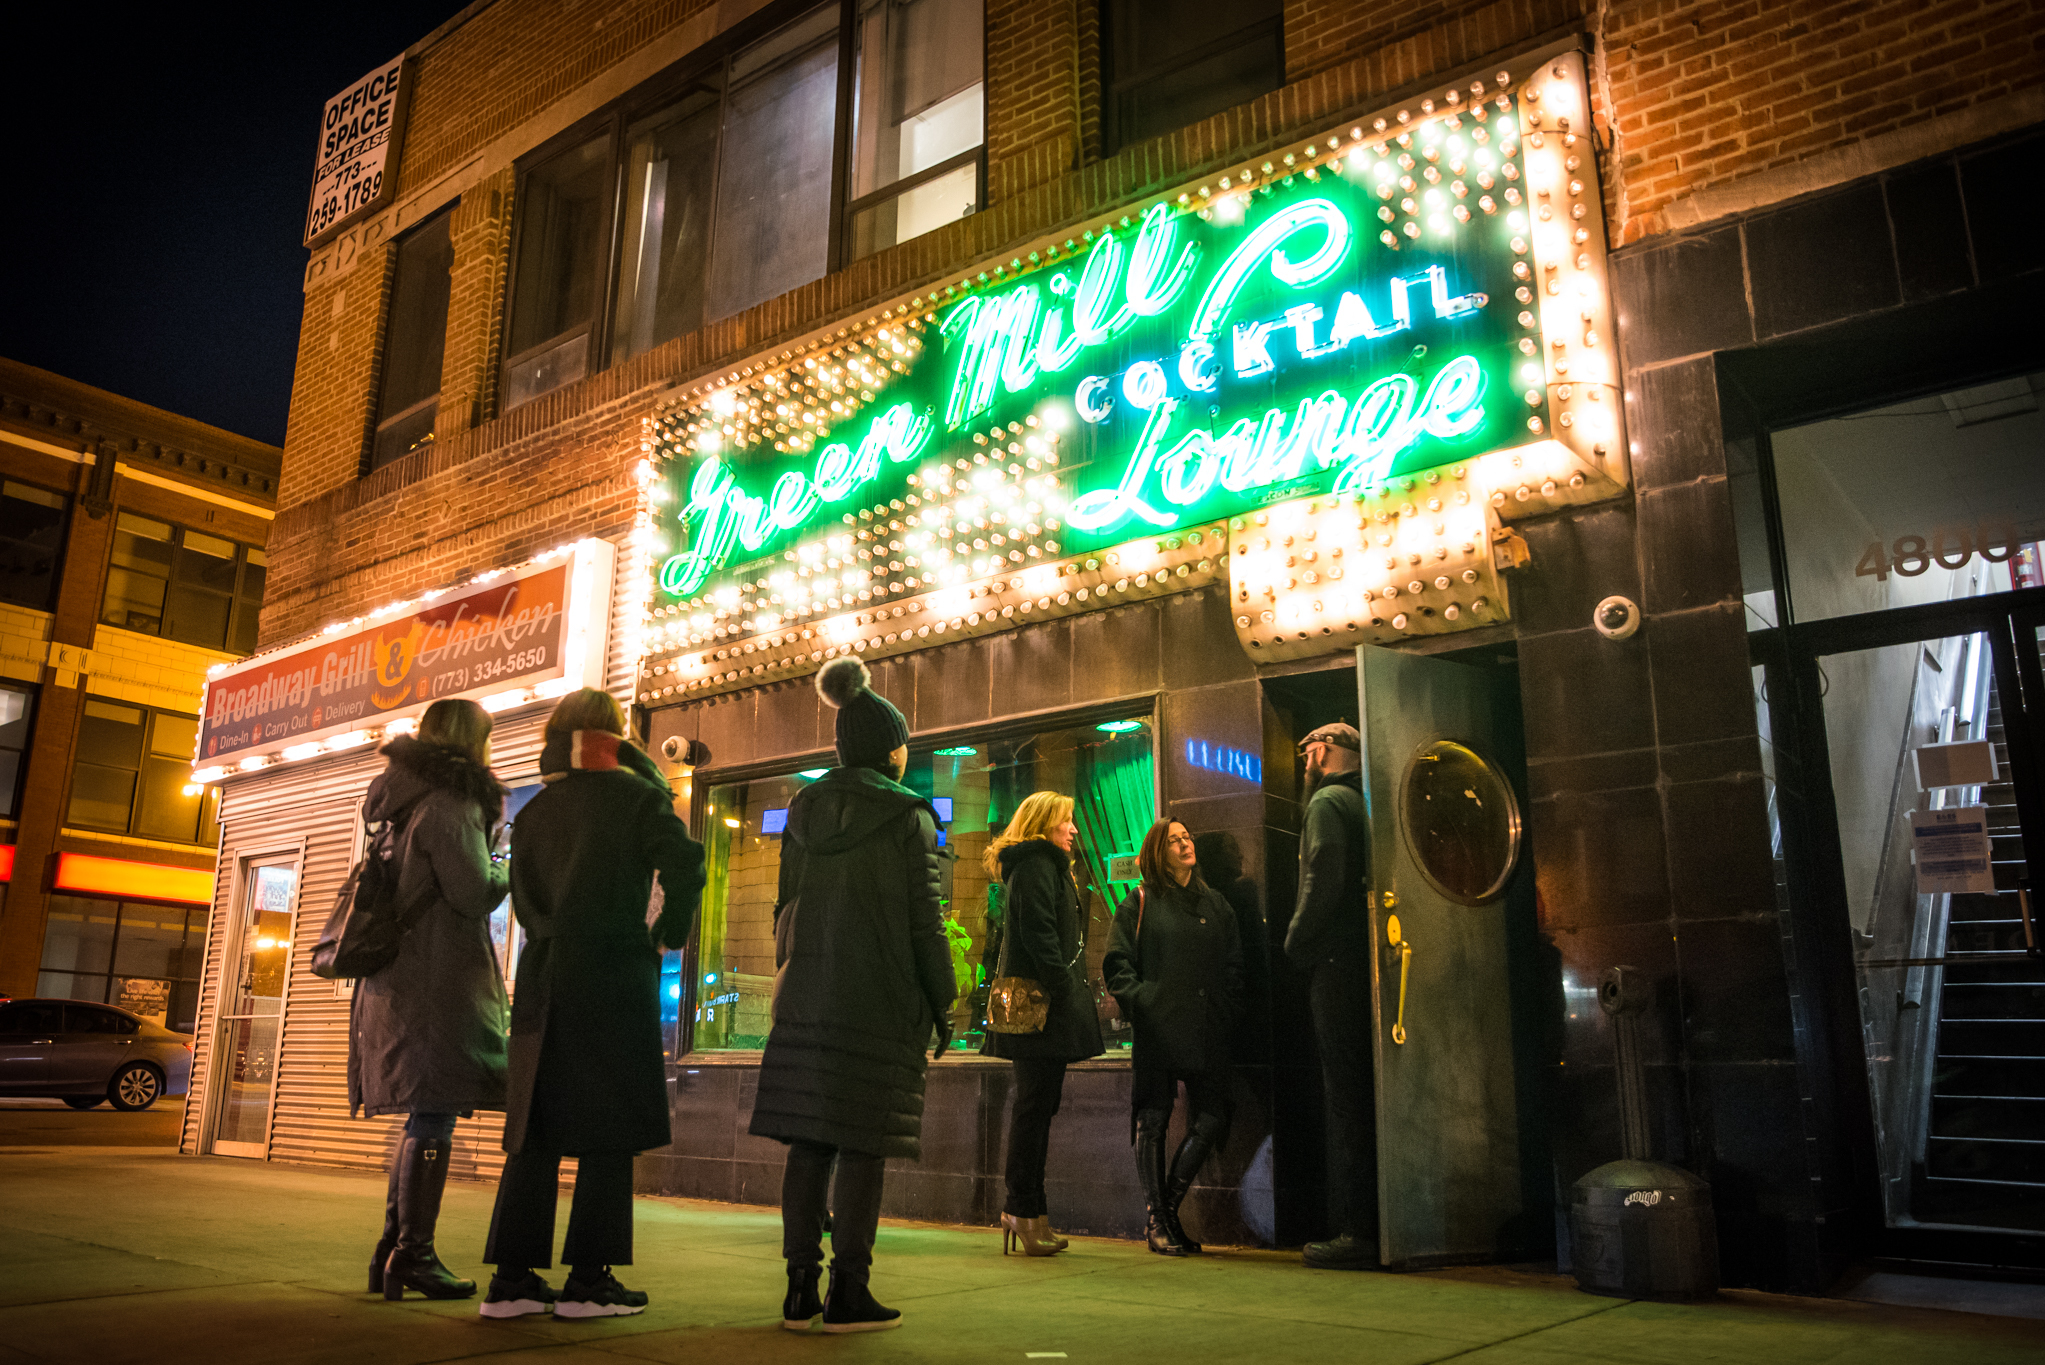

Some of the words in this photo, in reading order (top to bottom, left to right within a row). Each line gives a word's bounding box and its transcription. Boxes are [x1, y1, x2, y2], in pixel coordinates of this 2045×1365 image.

[325, 98, 392, 159] SPACE
[326, 65, 400, 130] OFFICE
[318, 156, 341, 181] FOR
[343, 129, 391, 164] LEASE
[311, 171, 382, 236] 259-1789
[1075, 265, 1487, 423] COCKTAIL
[660, 402, 934, 596] Green
[940, 202, 1203, 433] Mill
[211, 666, 317, 729] Broadway
[320, 640, 372, 697] Grill
[385, 642, 404, 680] &
[418, 586, 554, 667] Chicken
[432, 667, 469, 698] (773)
[473, 645, 546, 682] 334-5650
[220, 730, 249, 750] Dine-In
[265, 719, 289, 738] Carry
[291, 715, 308, 729] Out
[325, 700, 365, 721] Delivery
